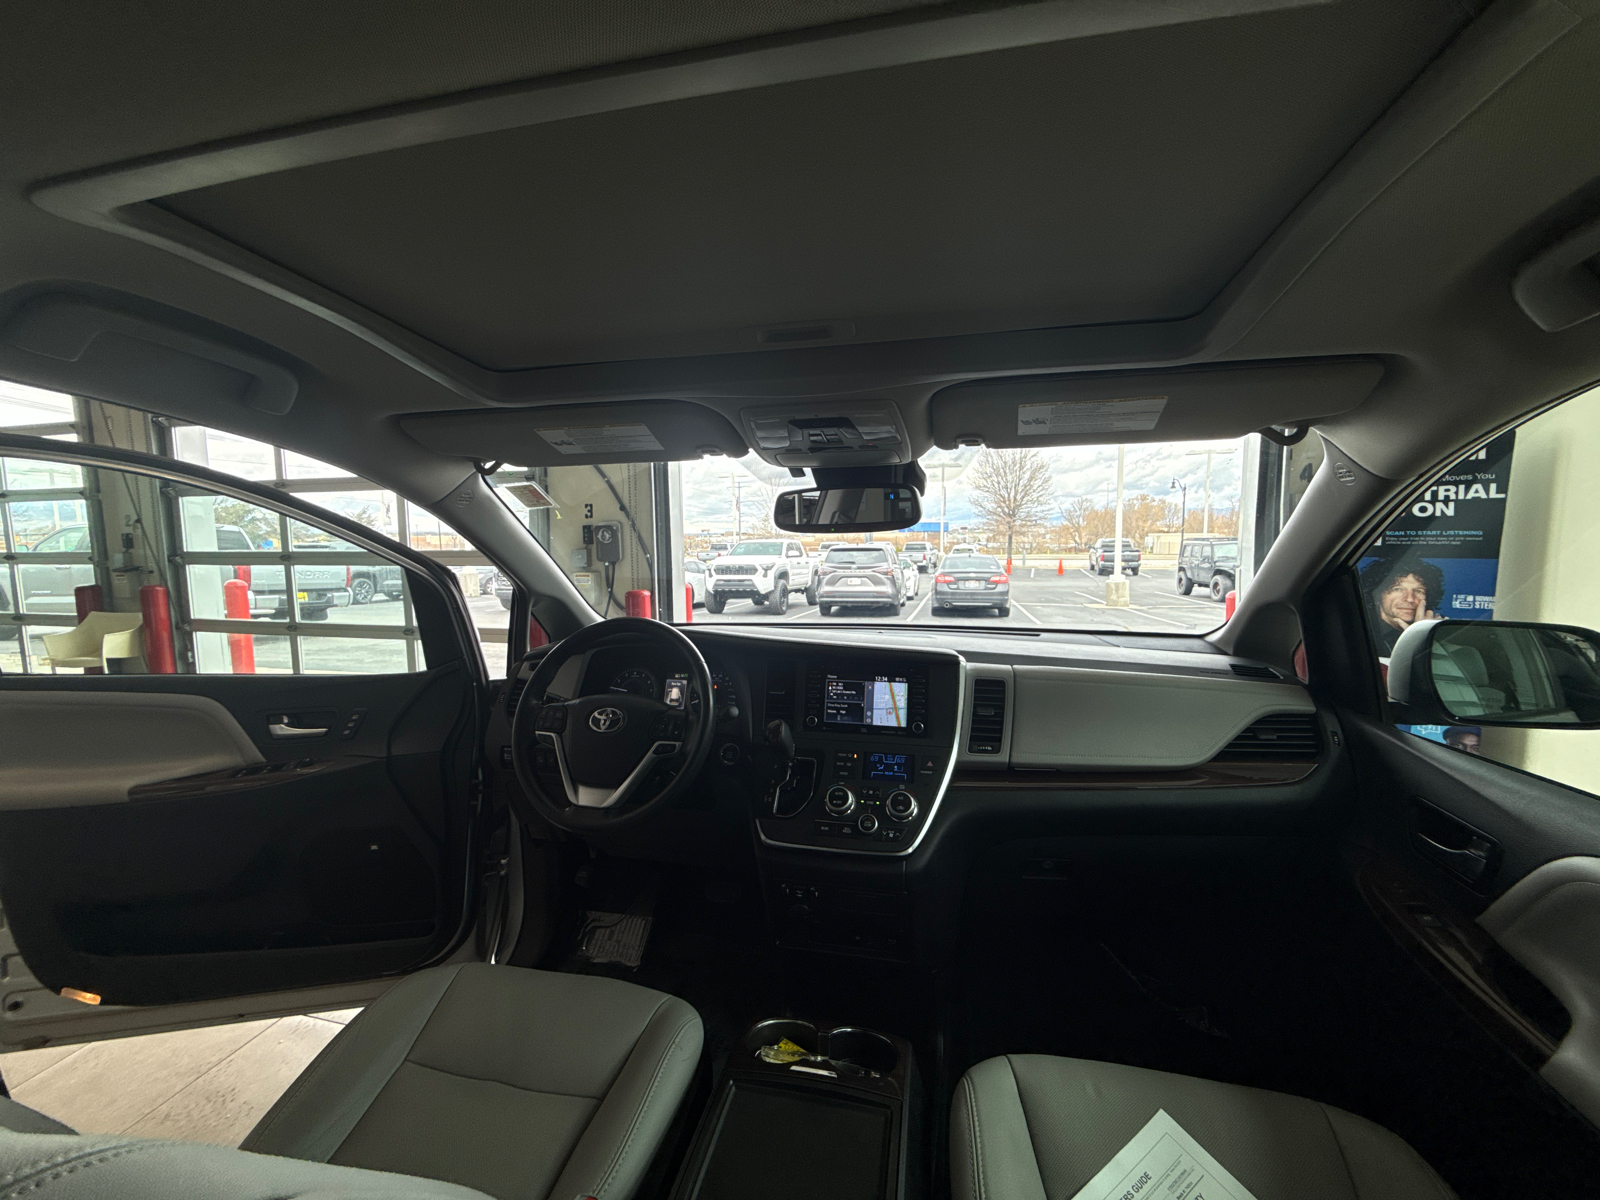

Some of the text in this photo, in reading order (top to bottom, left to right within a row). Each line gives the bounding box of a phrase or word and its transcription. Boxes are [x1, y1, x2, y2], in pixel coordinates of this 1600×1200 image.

[1300, 462, 1313, 483] 4
[1475, 471, 1496, 480] You
[1424, 483, 1506, 500] TRIAL
[584, 503, 593, 519] 3
[1411, 501, 1455, 518] ON
[124, 514, 133, 527] 2
[275, 570, 331, 579] TNDRA
[1131, 1171, 1153, 1193] GUIDE
